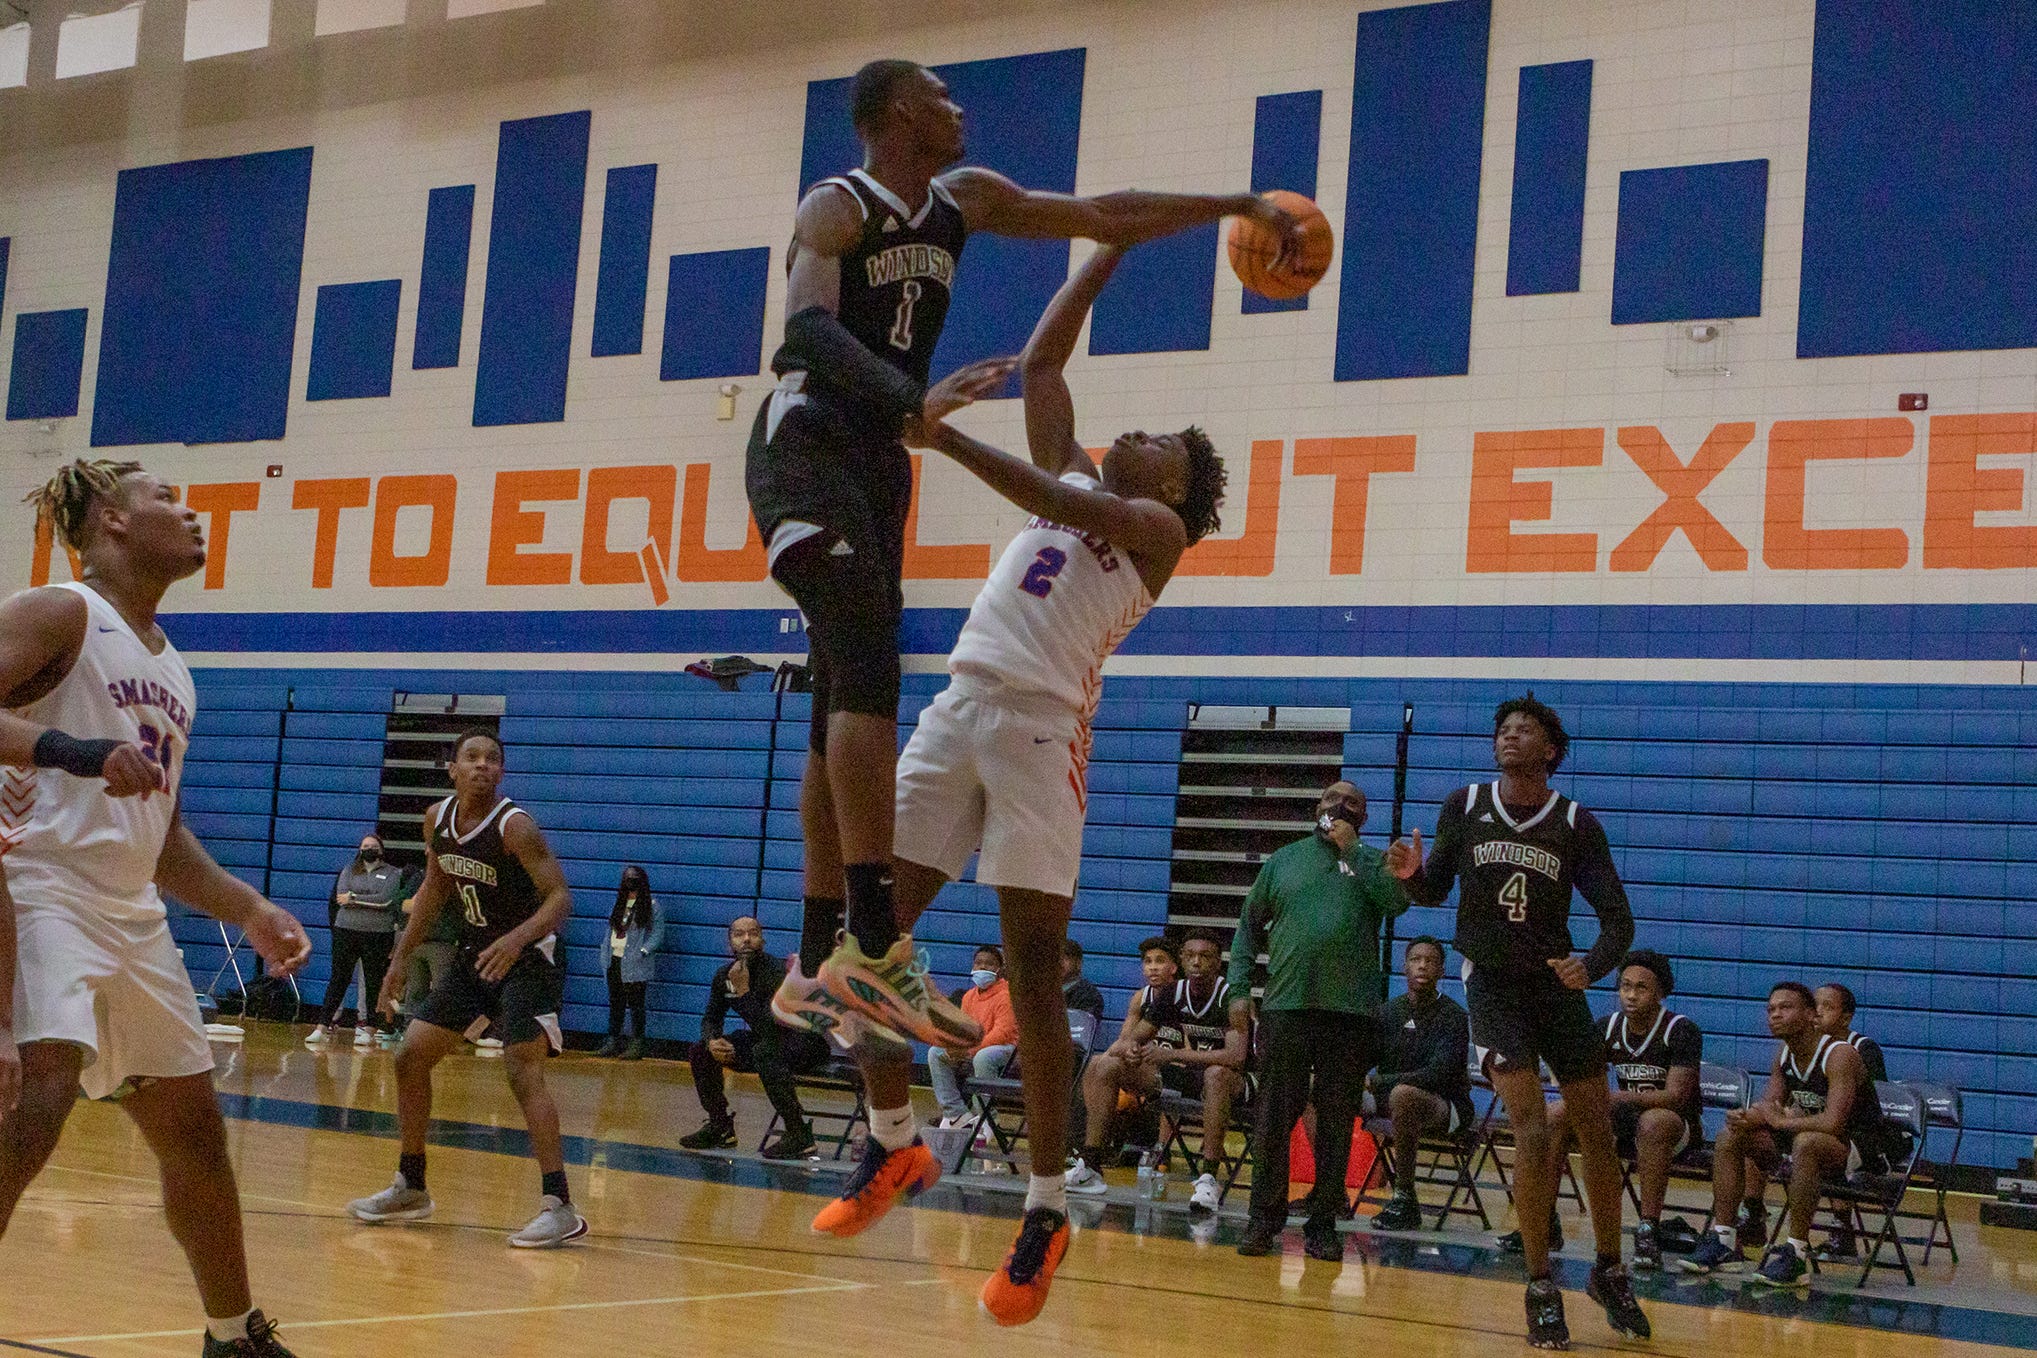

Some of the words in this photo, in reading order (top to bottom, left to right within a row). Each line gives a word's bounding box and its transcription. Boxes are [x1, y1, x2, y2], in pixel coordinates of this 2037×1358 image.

[292, 474, 457, 588] TO
[486, 455, 990, 606] EQUL
[1018, 546, 1067, 599] 2
[1474, 841, 1561, 881] WINDSOR
[1498, 872, 1528, 922] 4
